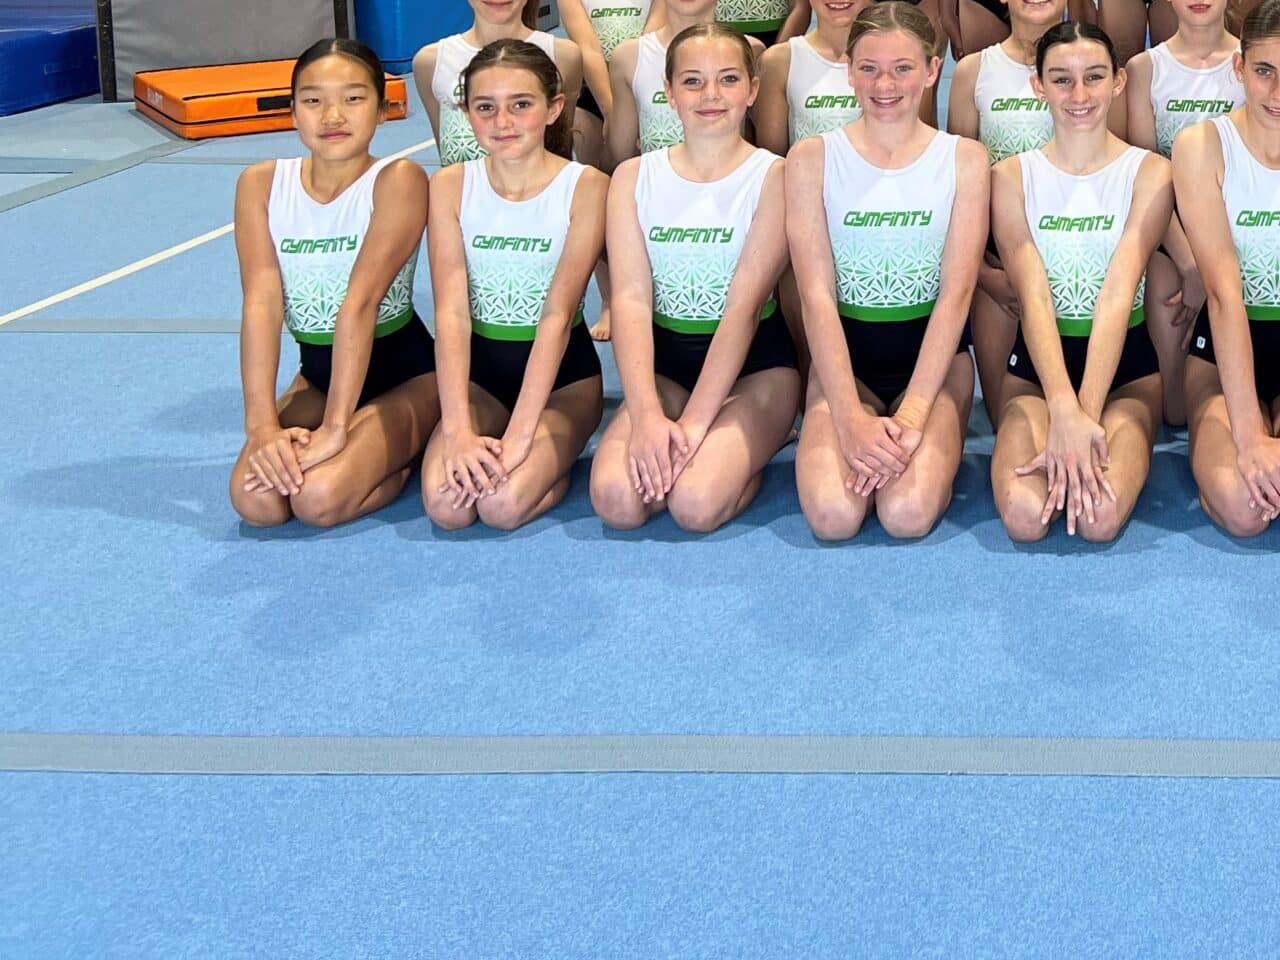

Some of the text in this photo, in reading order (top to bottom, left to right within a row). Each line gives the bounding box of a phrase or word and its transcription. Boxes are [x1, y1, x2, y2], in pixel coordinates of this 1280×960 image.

[590, 7, 641, 19] GYMFINITY
[804, 95, 861, 109] GYMFIN
[1166, 98, 1234, 112] GYMFINITY
[843, 209, 932, 227] GYMFINITY
[1038, 214, 1115, 231] GYMFINITY
[648, 226, 735, 243] GYMFINITY
[279, 234, 358, 255] GYMFINITY
[472, 234, 552, 253] GYMFINITY
